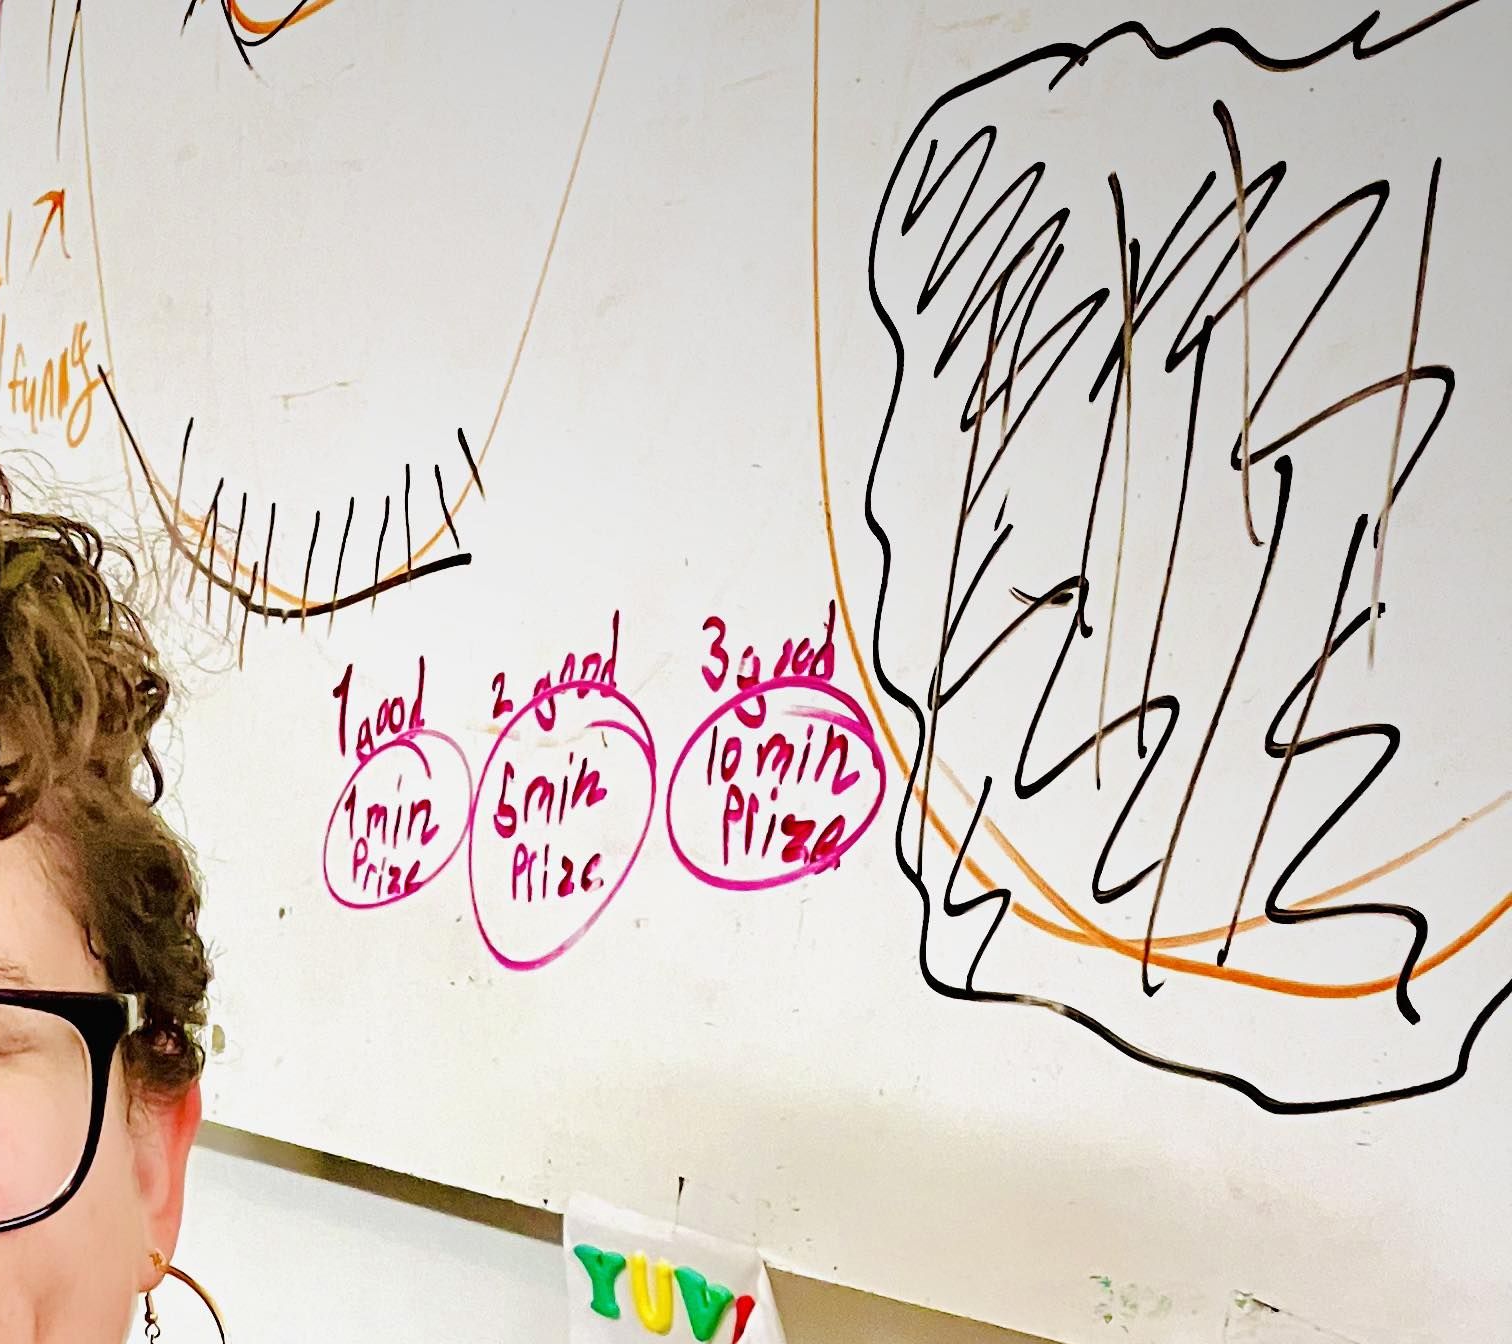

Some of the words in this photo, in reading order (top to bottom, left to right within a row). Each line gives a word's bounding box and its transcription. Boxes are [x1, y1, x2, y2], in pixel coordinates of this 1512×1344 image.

[7, 320, 110, 449] funny
[333, 663, 353, 757] 1
[355, 655, 426, 764] good
[491, 671, 514, 719] 2
[533, 609, 621, 731] good
[701, 615, 729, 693] 3
[734, 599, 835, 729] good
[524, 752, 608, 825] min
[706, 725, 743, 786] 10
[756, 723, 860, 795] min
[345, 784, 357, 840] 1
[366, 774, 440, 849] min
[352, 837, 423, 898] Prize
